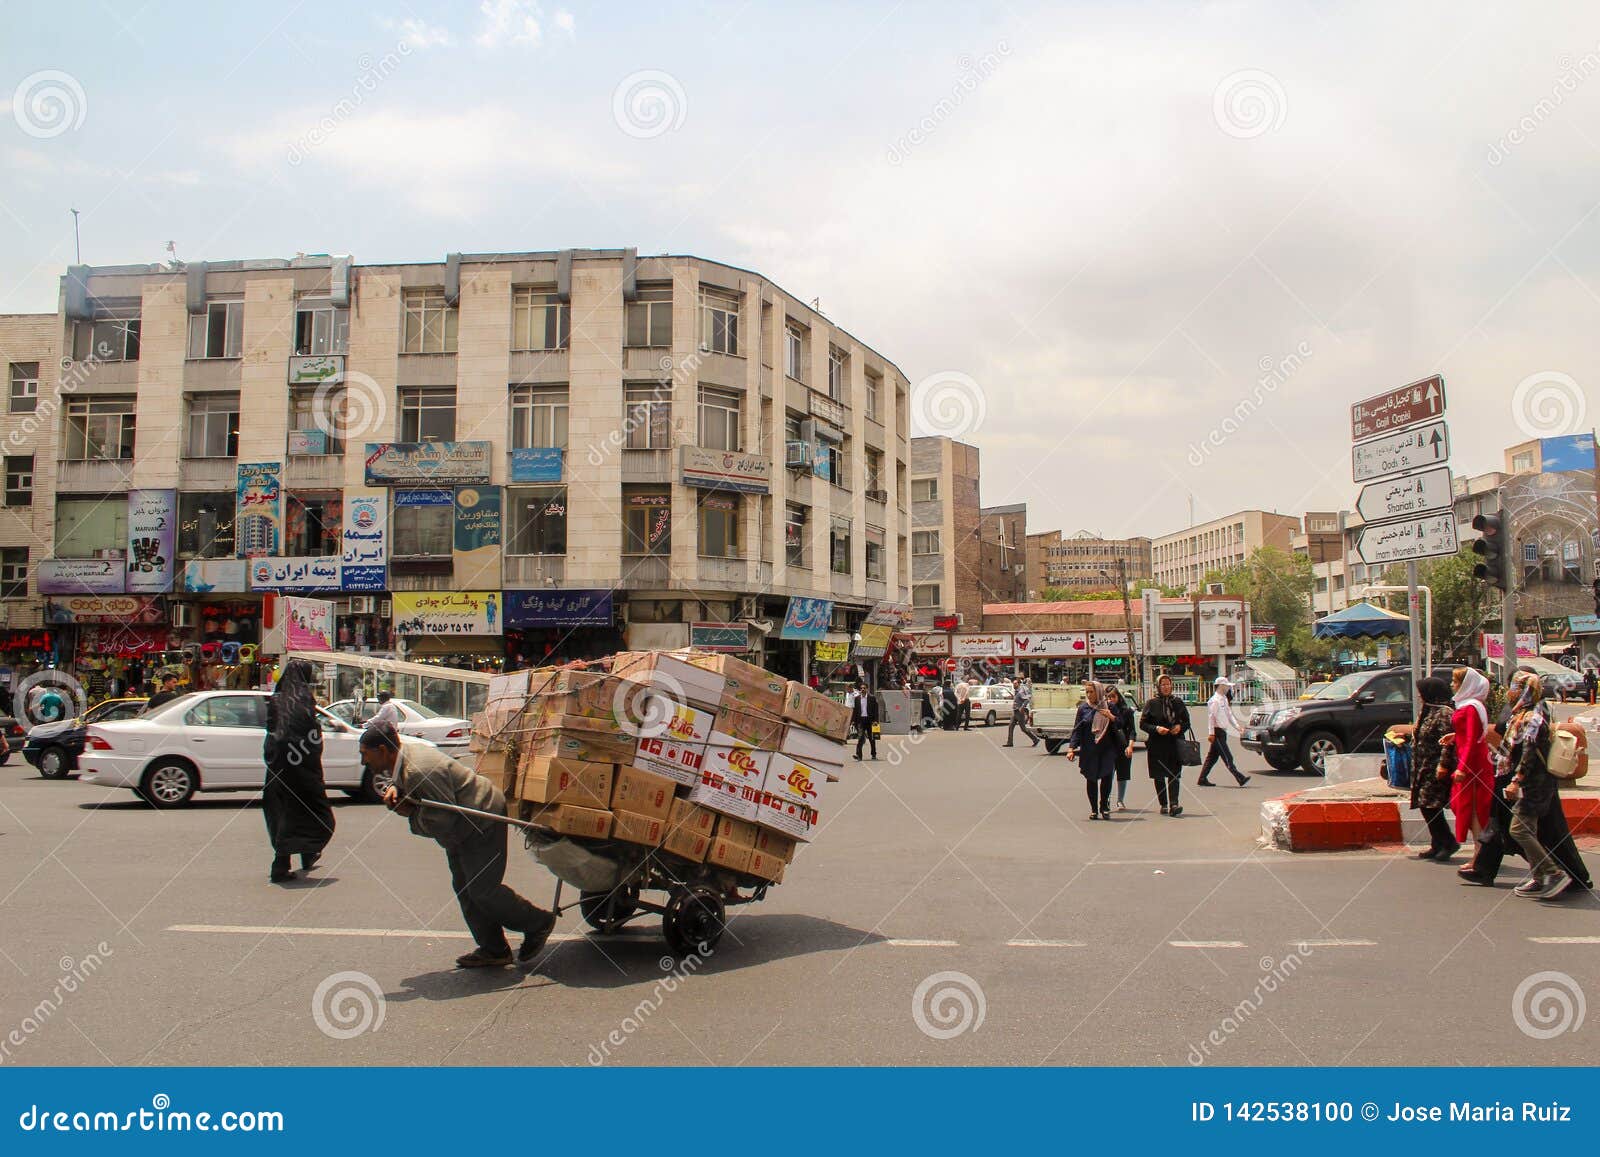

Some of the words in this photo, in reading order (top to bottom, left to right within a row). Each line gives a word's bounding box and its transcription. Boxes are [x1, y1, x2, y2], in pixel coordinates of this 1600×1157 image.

[241, 488, 277, 506] تبریز
[1386, 480, 1413, 500] شریعتی
[1387, 500, 1414, 513] Shariati
[1418, 498, 1427, 507] St.
[344, 529, 383, 543] بیمه
[343, 548, 383, 562] ایران
[274, 563, 308, 581] ایران
[311, 565, 337, 580] بیمه
[416, 597, 440, 608] جوادی
[442, 594, 478, 610] پوشاک
